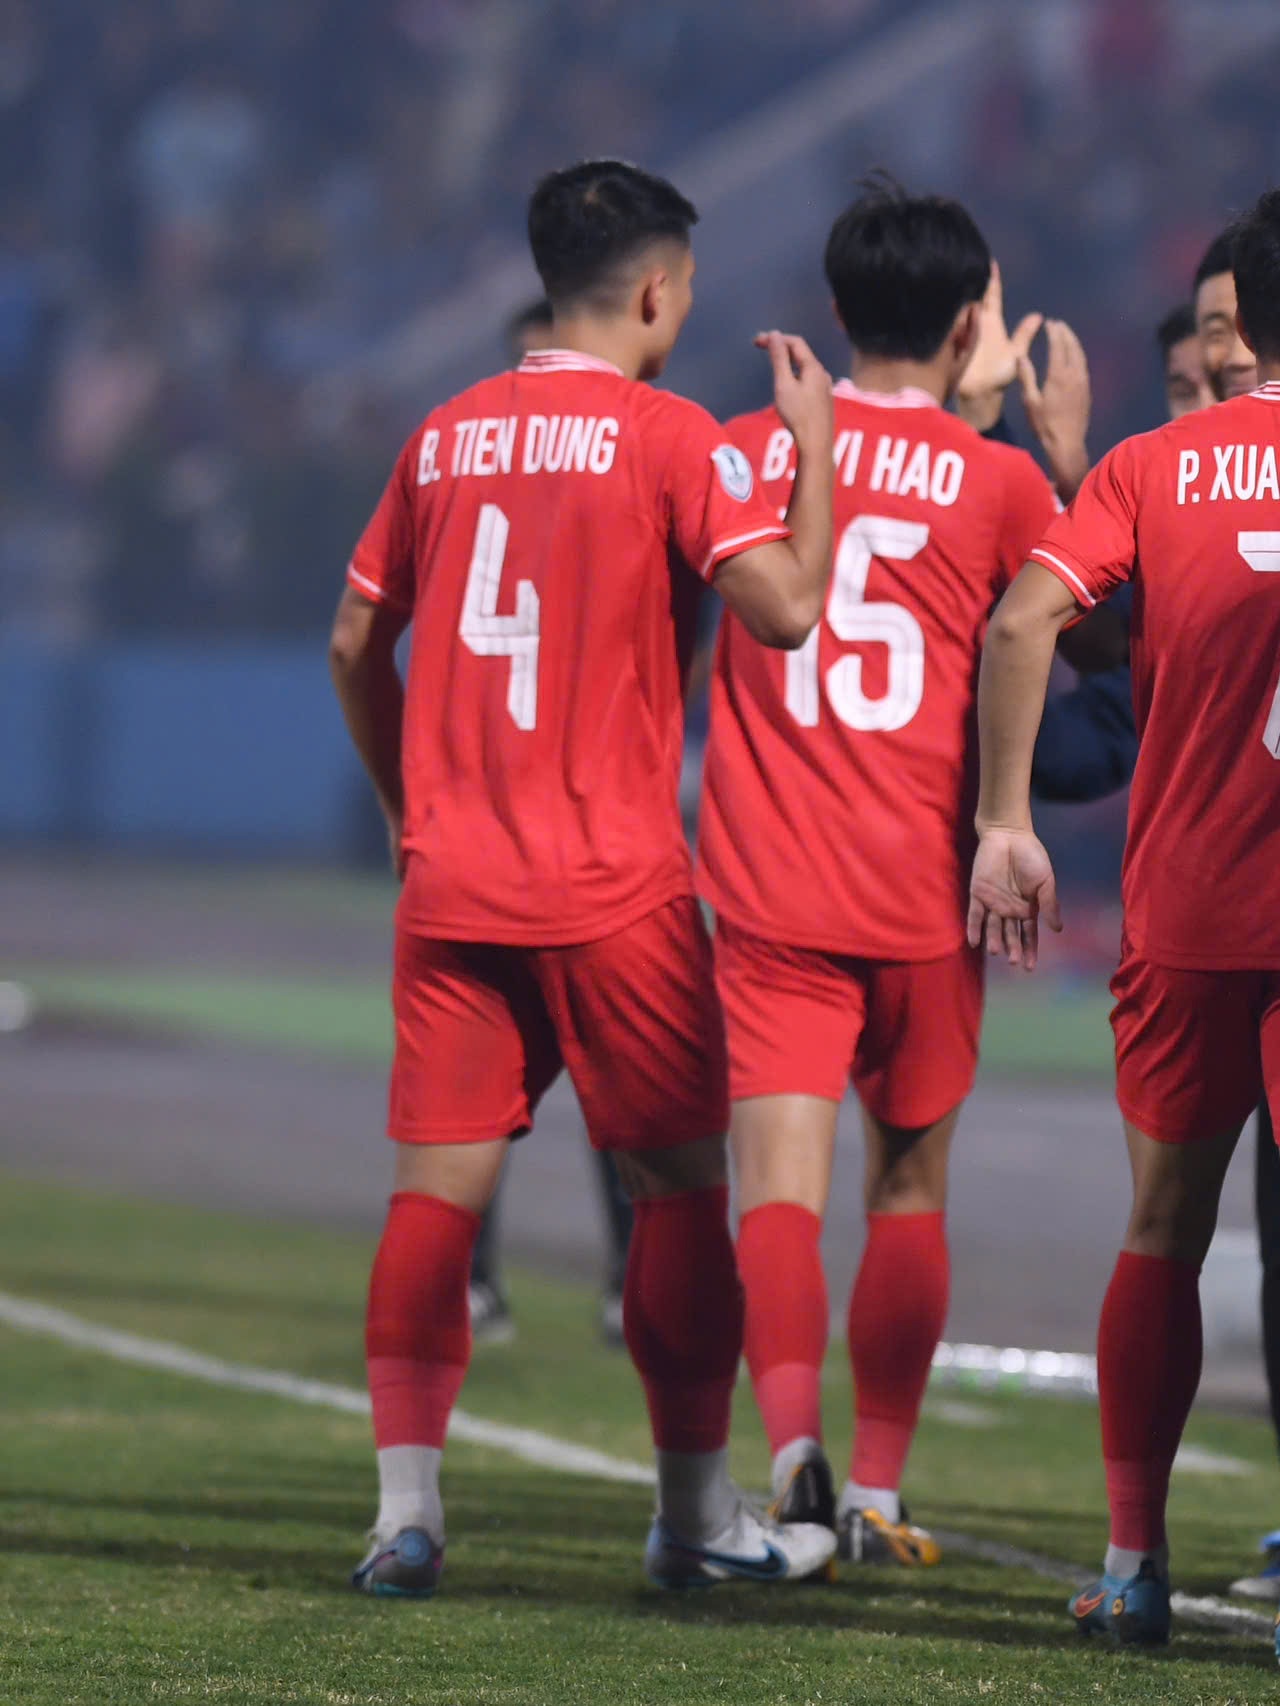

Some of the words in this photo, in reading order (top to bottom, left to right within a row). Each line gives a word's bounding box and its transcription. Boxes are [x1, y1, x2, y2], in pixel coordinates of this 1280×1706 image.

[417, 428, 441, 486] B.
[450, 416, 517, 477] TIEN
[521, 414, 620, 475] DUNG
[760, 427, 797, 482] B.
[869, 434, 966, 507] HAO
[1176, 449, 1201, 505] P.
[458, 503, 540, 731] 4
[778, 507, 930, 733] 15
